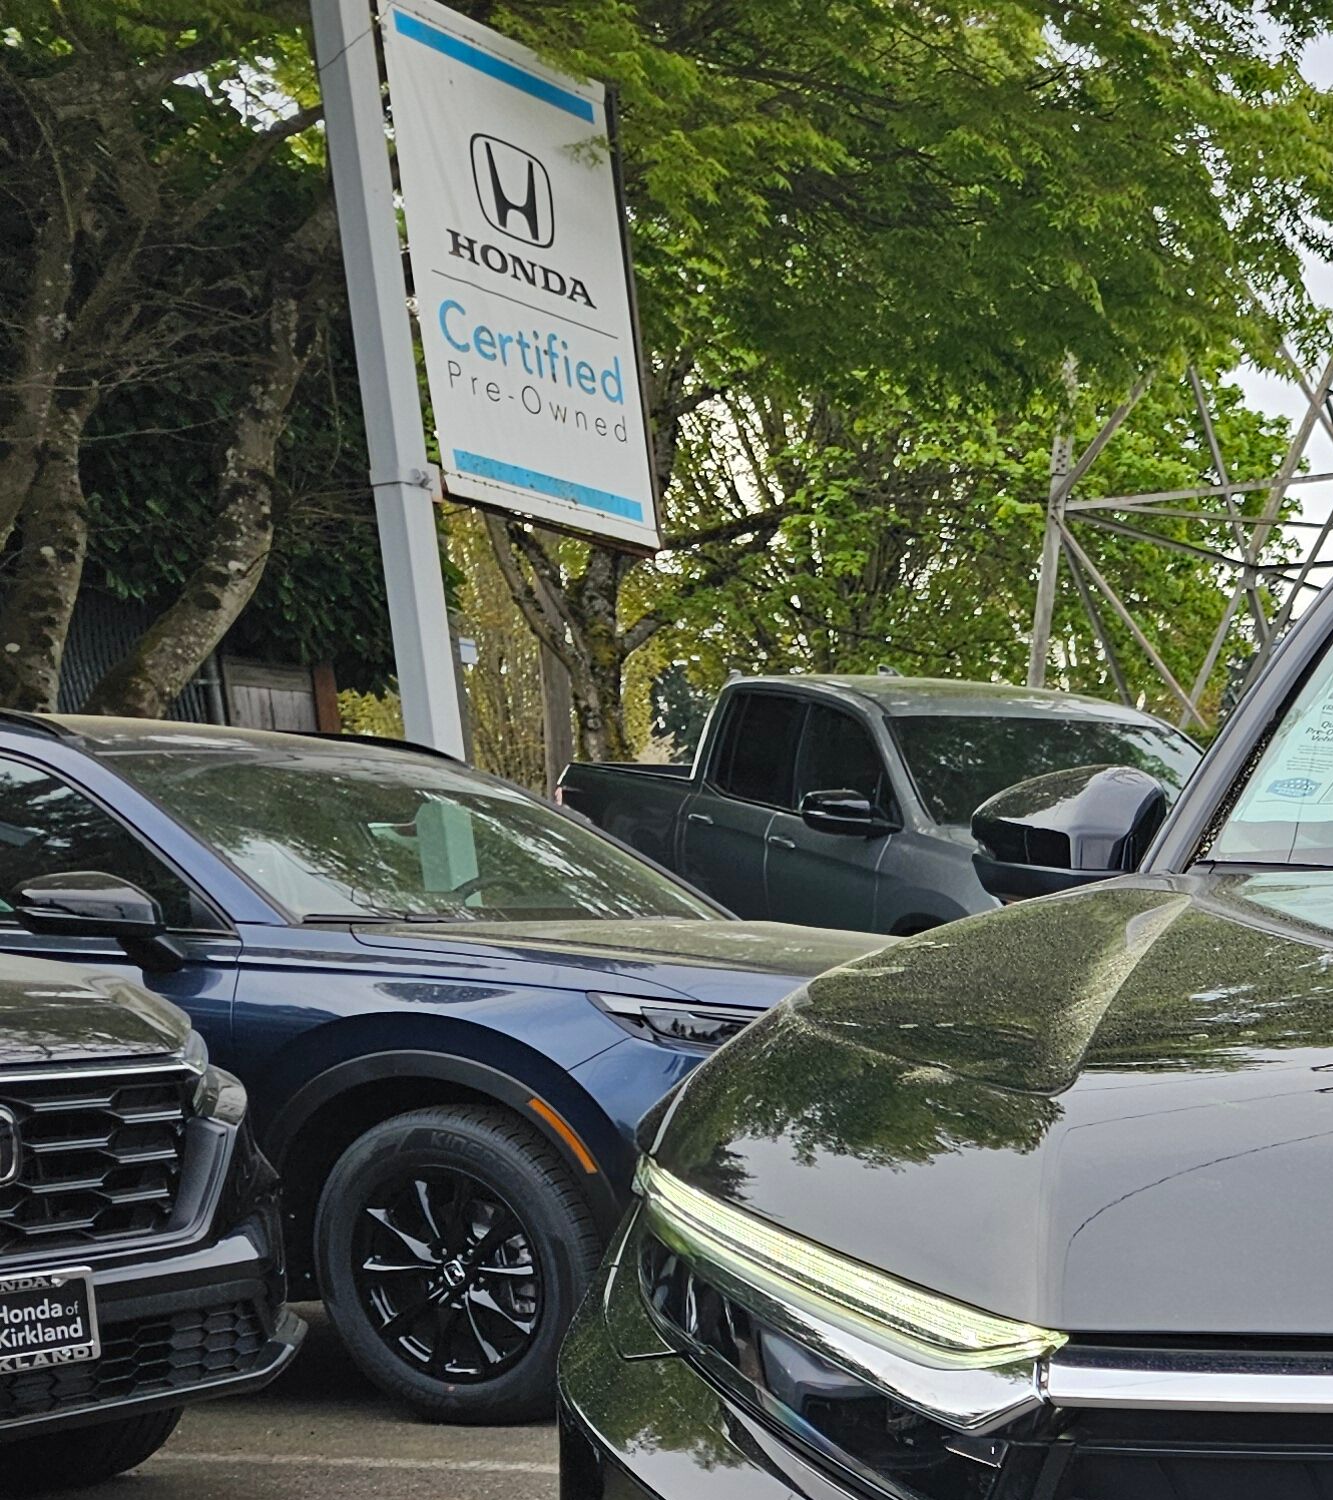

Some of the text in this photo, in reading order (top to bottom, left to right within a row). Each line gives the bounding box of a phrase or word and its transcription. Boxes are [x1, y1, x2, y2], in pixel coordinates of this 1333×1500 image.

[445, 228, 597, 309] HONDA
[438, 300, 623, 404] Certified
[447, 360, 628, 443] Pre-Owned
[0, 1316, 83, 1349] Kirkland
[65, 1300, 78, 1315] of
